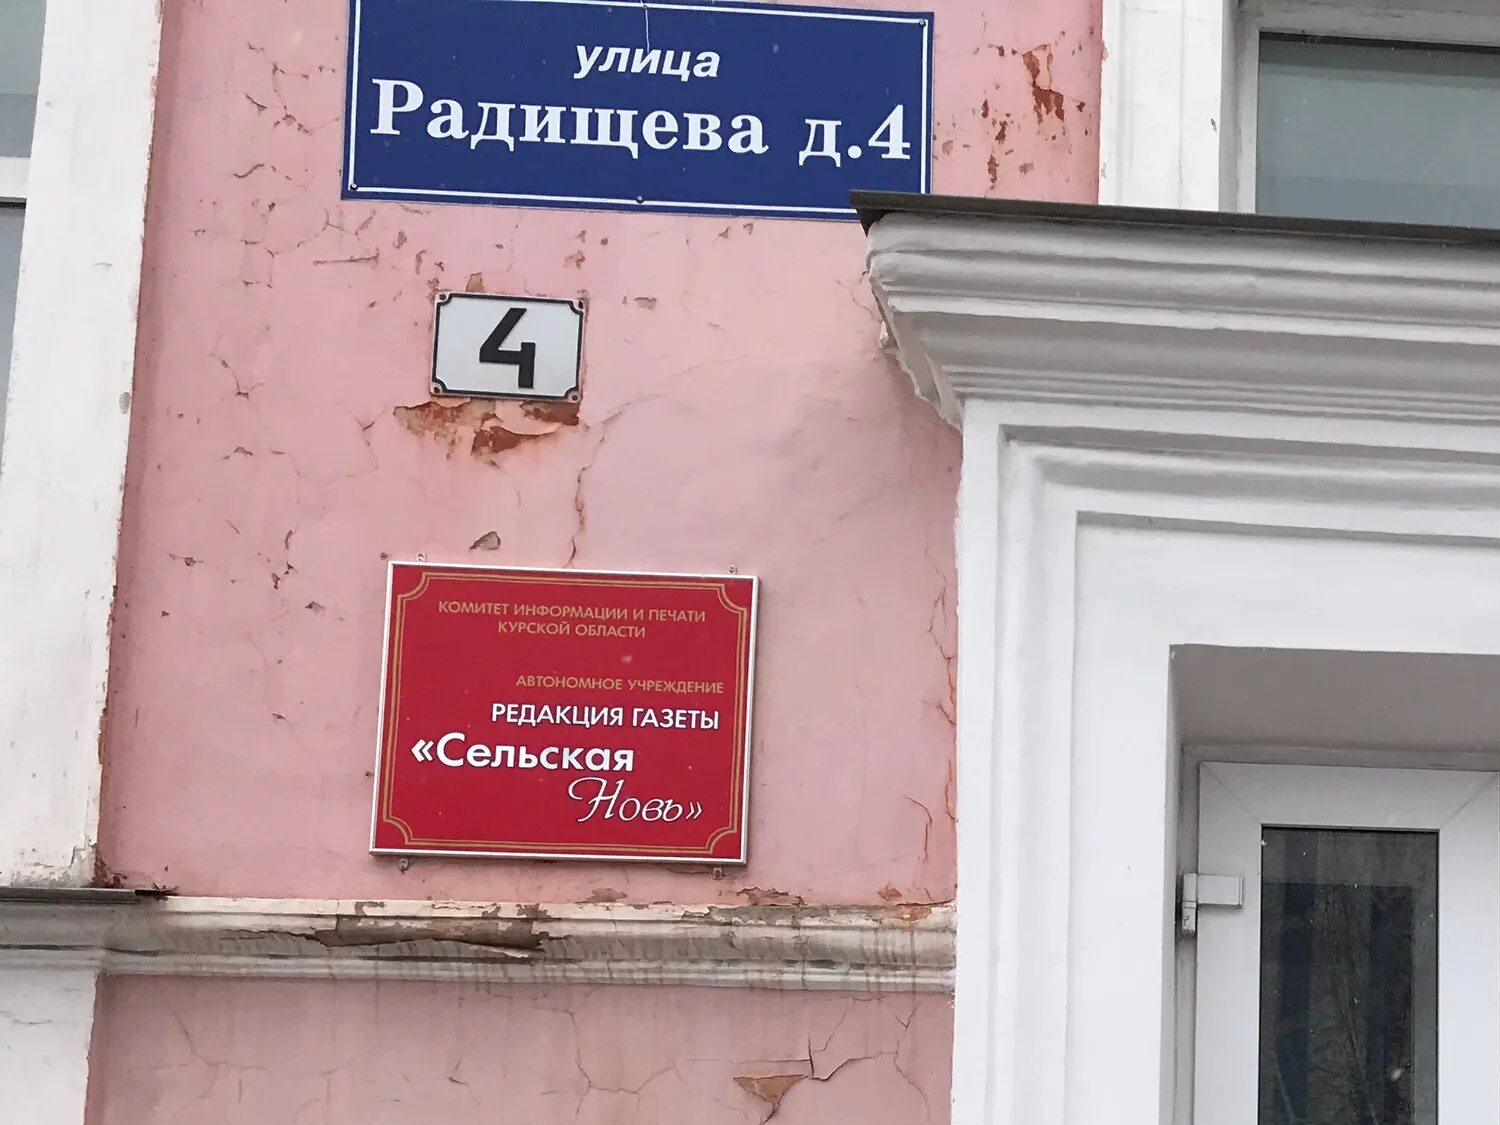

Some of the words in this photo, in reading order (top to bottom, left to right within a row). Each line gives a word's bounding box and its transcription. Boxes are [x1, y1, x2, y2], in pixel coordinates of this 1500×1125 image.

[573, 43, 721, 81] улица
[369, 78, 769, 160] Радищева
[798, 103, 911, 168] д.4
[478, 306, 536, 390] 4
[438, 601, 510, 616] КОМИТЕТ
[513, 604, 628, 621] ИНФОРМАЦИИ
[633, 608, 644, 620] И
[649, 609, 706, 622] ПЕЧАТИ
[498, 621, 570, 635] КУРСКОЙ
[575, 624, 646, 639] ОБЛАСТИ
[516, 675, 623, 690] АВТОНОМНОЕ
[627, 679, 724, 694] УЧРЕЖДЕНИЕ
[491, 703, 624, 727] РЕДАКЦИЯ
[632, 707, 719, 730] ГАЗЕТЫ
[410, 732, 635, 772] «Сельская
[568, 776, 703, 822] Новь»
